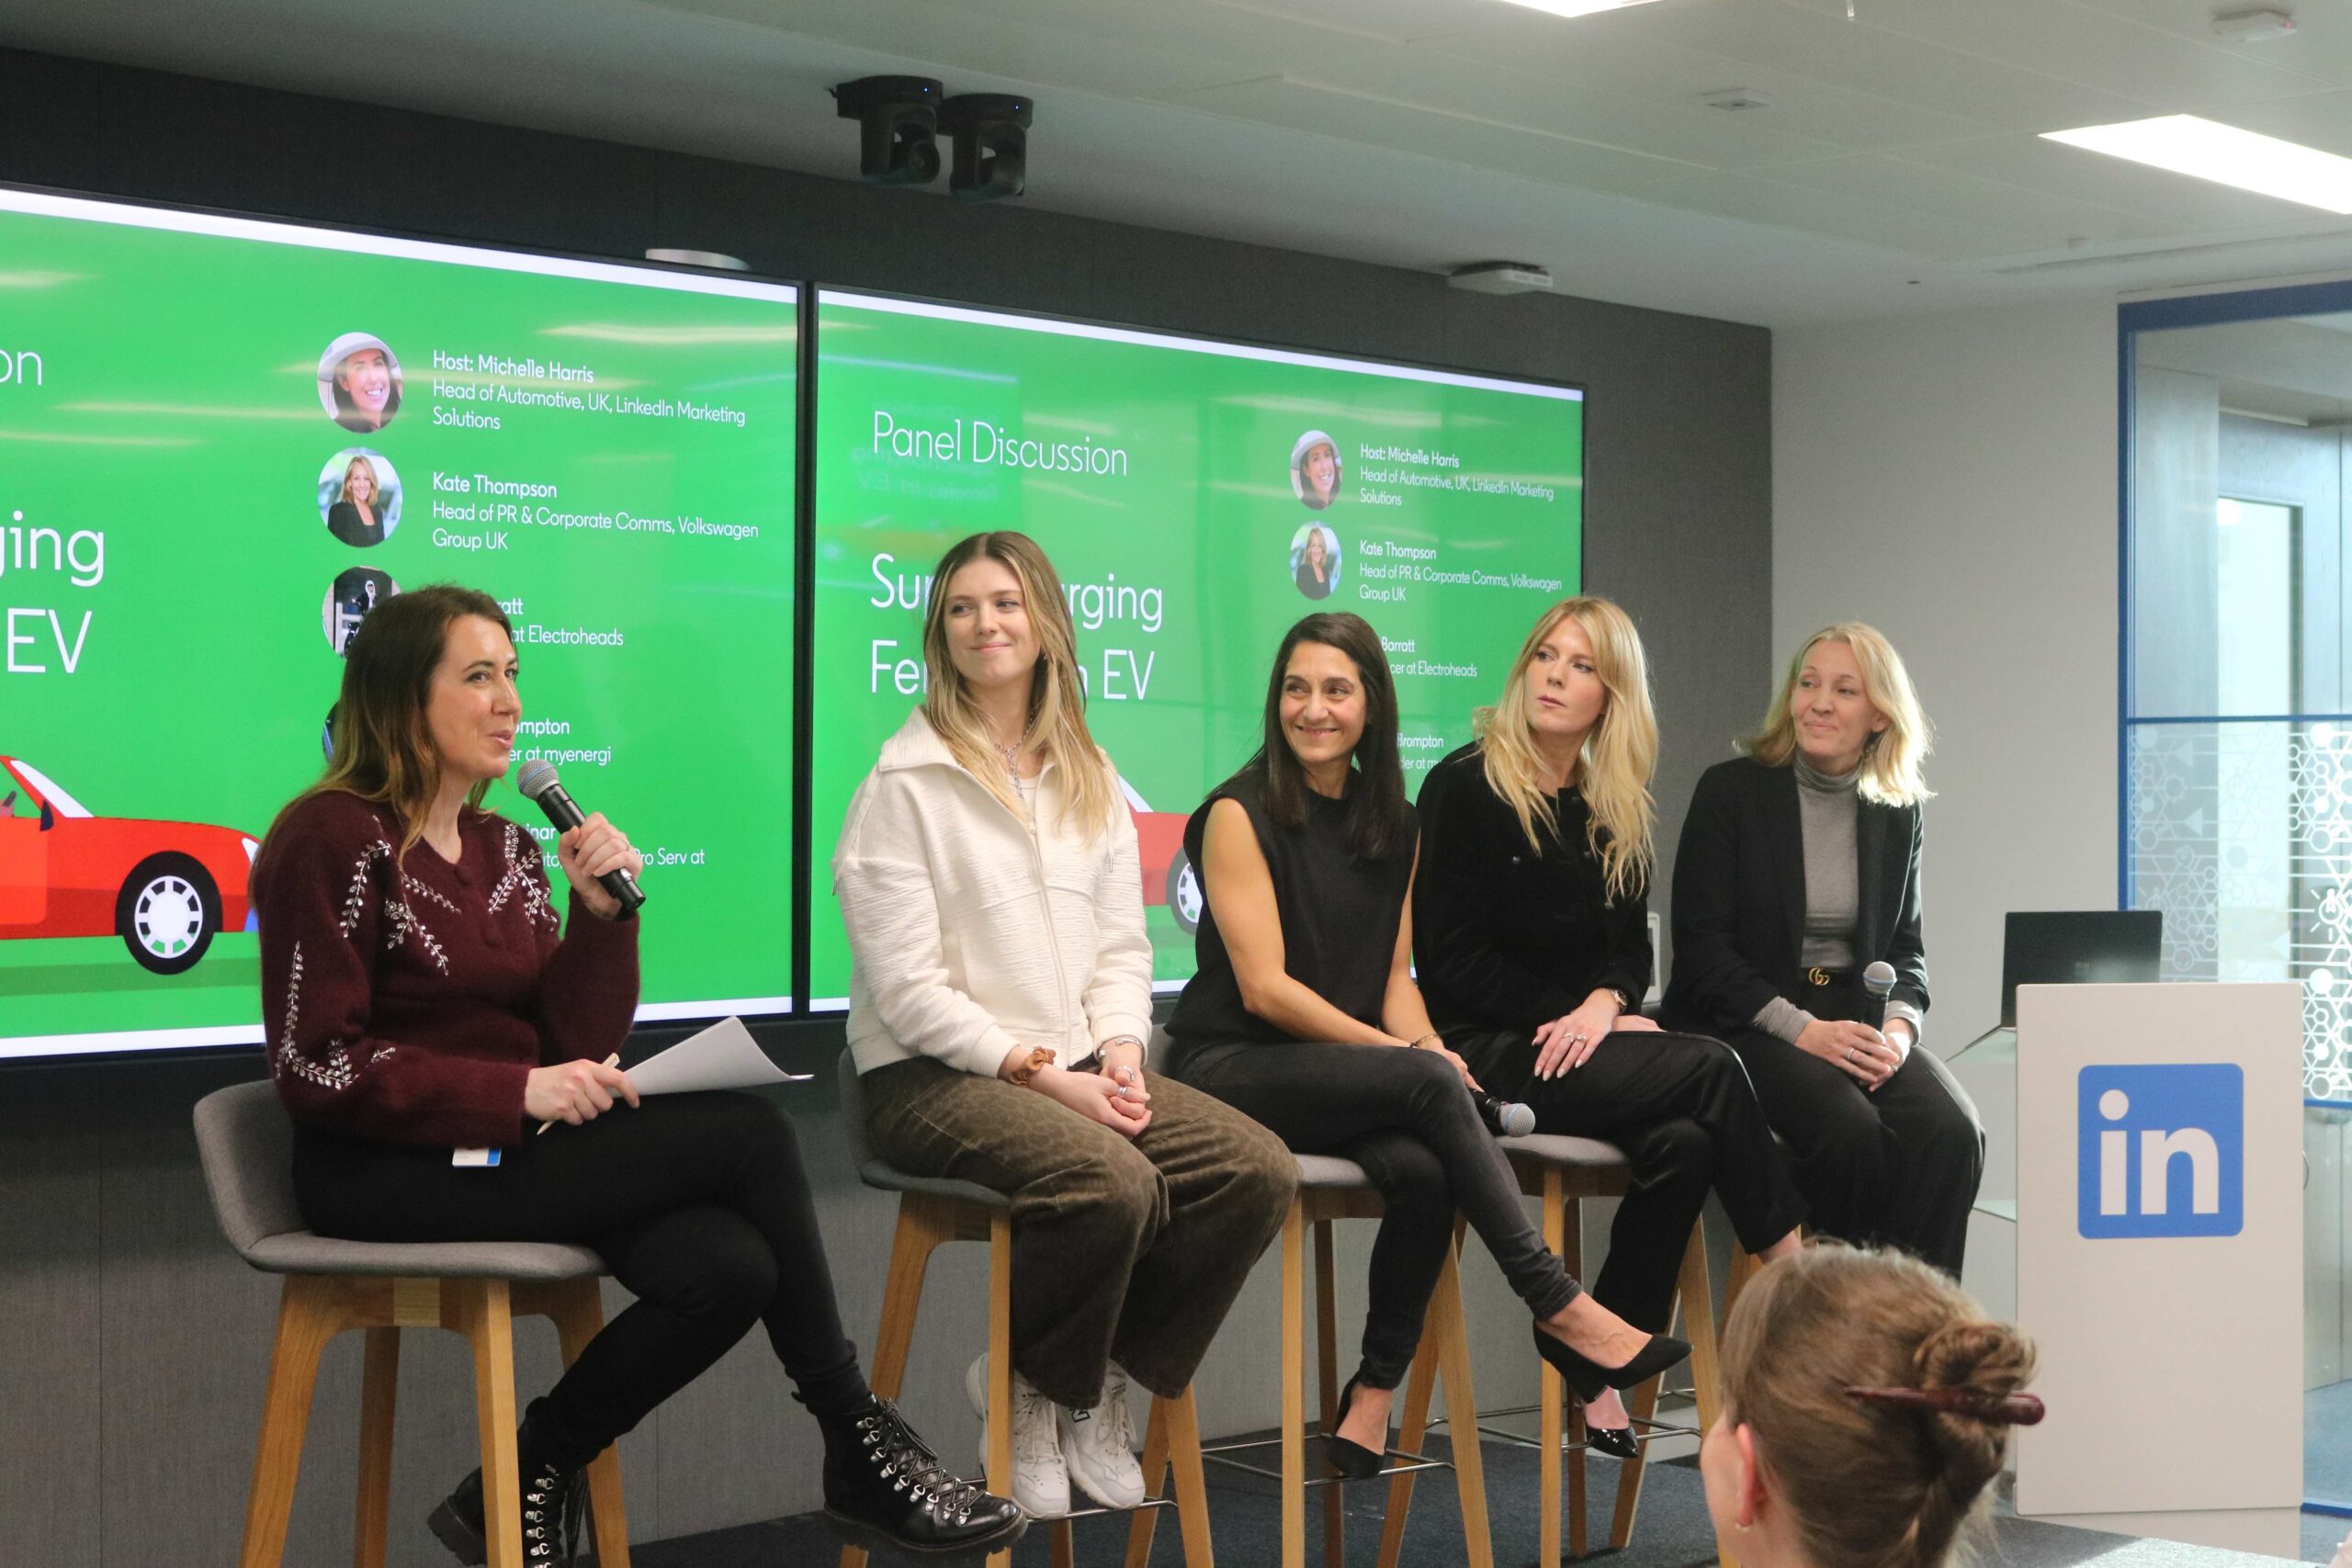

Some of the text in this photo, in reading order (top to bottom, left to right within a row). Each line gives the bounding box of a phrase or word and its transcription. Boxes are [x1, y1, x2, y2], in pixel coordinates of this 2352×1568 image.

[434, 350, 594, 383] Host: Michelle Harris
[434, 378, 746, 427] Head of Automotive, UK, LinkedIn Marketing
[434, 406, 501, 430] Solutions
[874, 411, 961, 461] Panel
[973, 421, 1128, 476] Discussion
[1361, 443, 1460, 468] Host: Michelle Harris
[434, 470, 558, 500] Kate Thompson
[1361, 467, 1555, 502] Head of Automotive, UK, LinkedIn Marketing
[1361, 488, 1402, 506] Solutions
[434, 501, 759, 540] Head of PR & Corporate Comms, Volkswagen
[433, 528, 508, 551] Group UK
[1360, 539, 1437, 560] Kate Thompson
[1360, 563, 1562, 592] Head of PR & Corporate Comms, Volkswagen
[1360, 584, 1406, 603] Group UK
[7, 607, 93, 673] EV
[528, 625, 624, 646] Electroheads
[1382, 636, 1416, 653] Barratt
[1103, 649, 1155, 700] EV
[1407, 661, 1417, 675] at
[1419, 660, 1477, 677] Electroheads
[526, 746, 540, 761] at
[545, 745, 612, 766] myenergi
[1416, 757, 1426, 770] at
[658, 847, 687, 865] Serv
[691, 849, 706, 864] at
[2098, 1089, 2220, 1215] in
